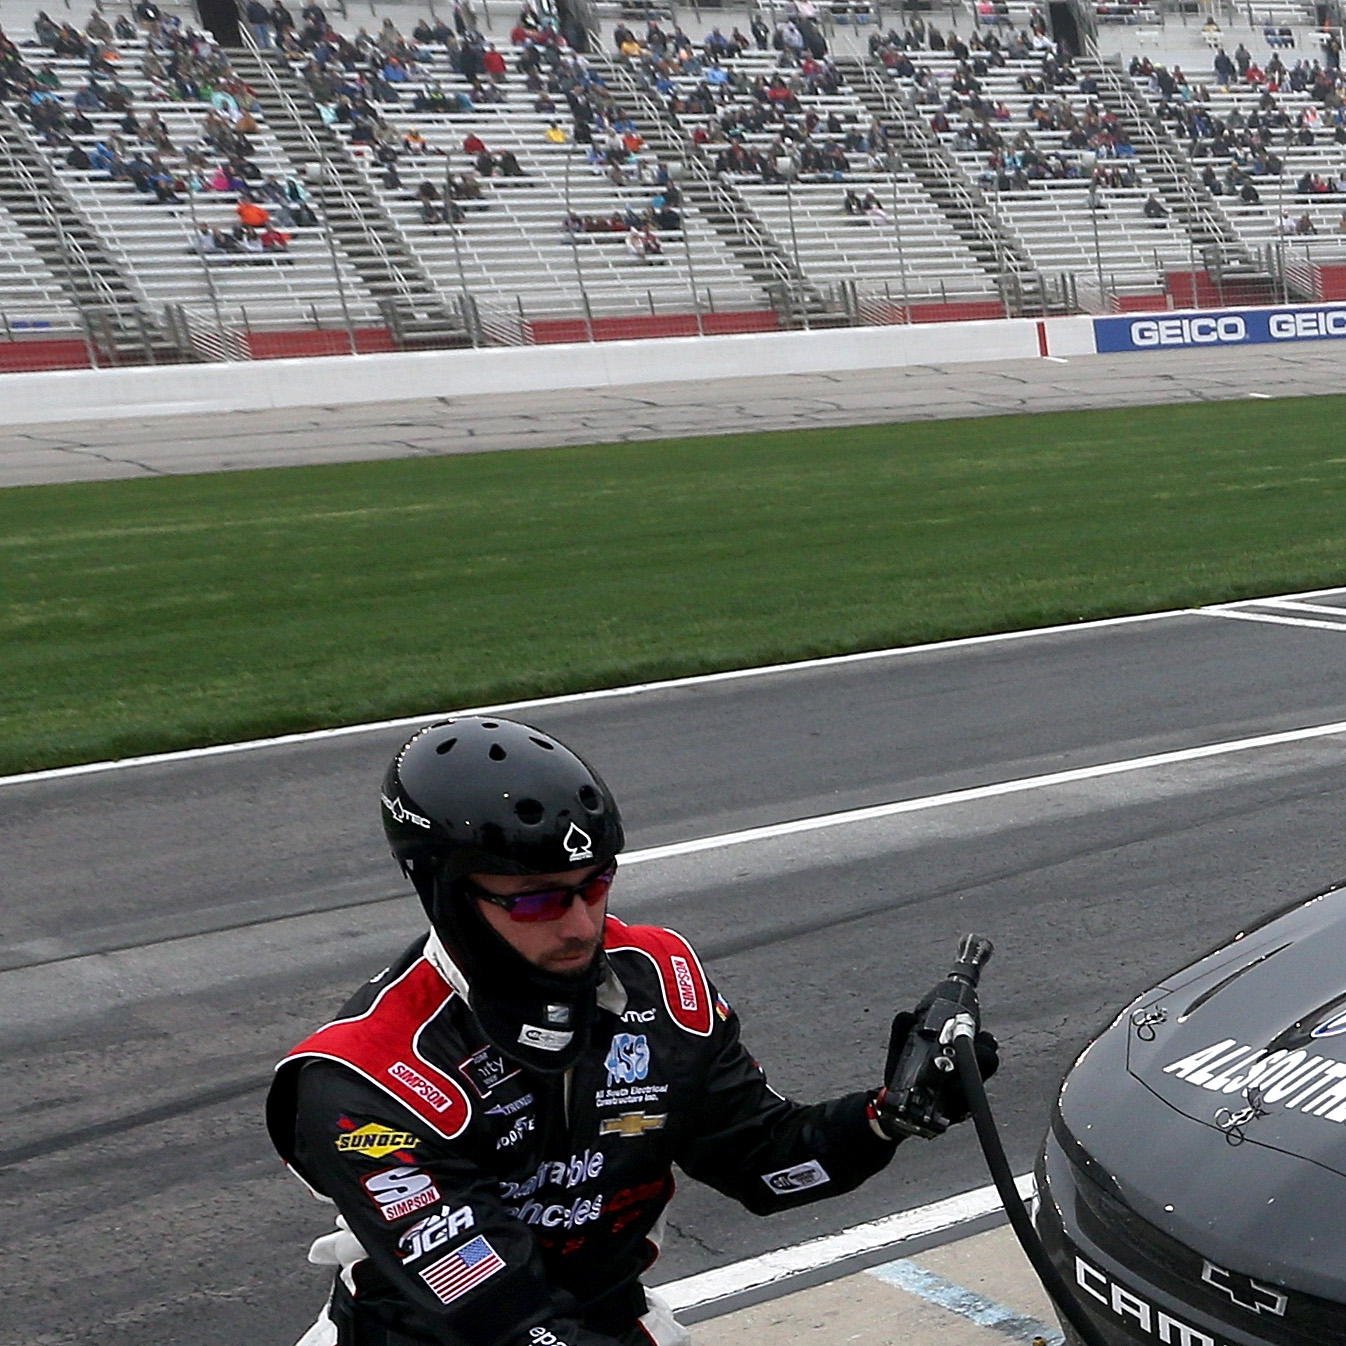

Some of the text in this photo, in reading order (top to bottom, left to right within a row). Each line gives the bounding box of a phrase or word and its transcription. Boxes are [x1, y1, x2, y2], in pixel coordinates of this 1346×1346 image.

[1131, 315, 1245, 346] GEICO
[674, 959, 697, 1009] SIMPSON
[391, 1064, 449, 1110] SIMPSON
[338, 1132, 417, 1150] SUNOCO
[385, 1190, 437, 1220] SIMPSON
